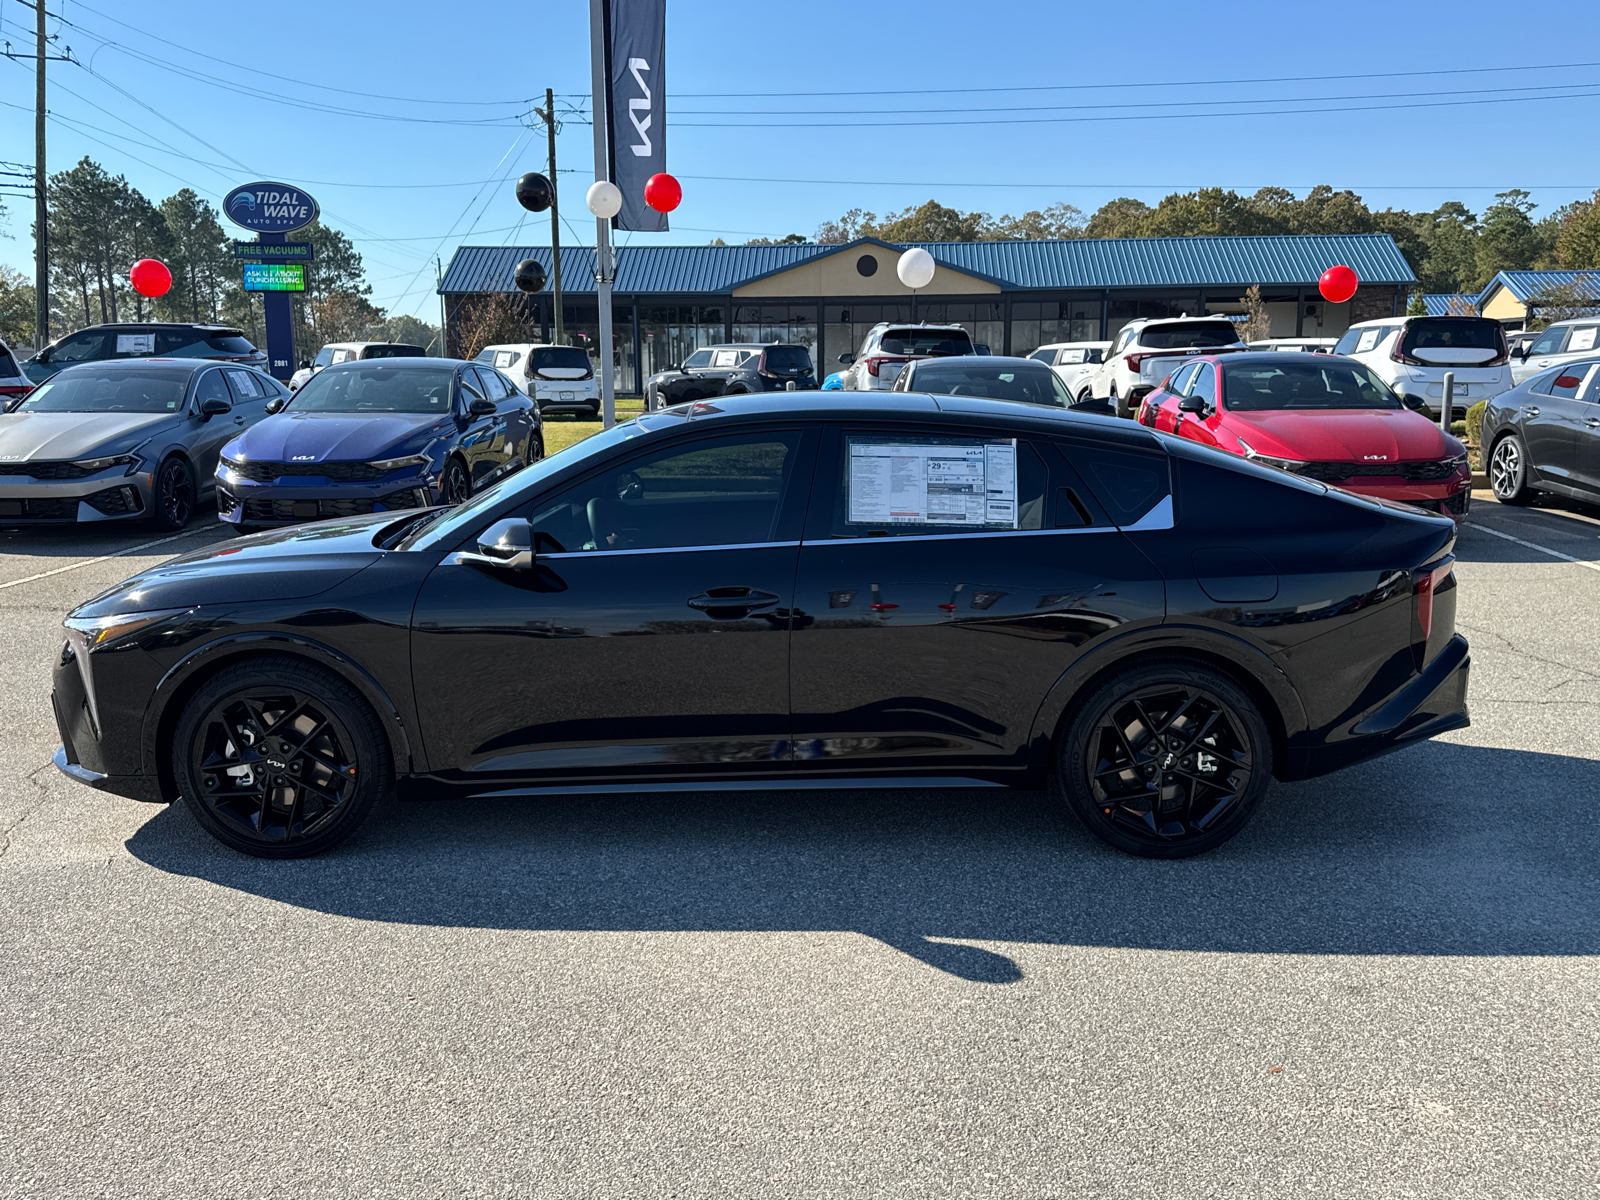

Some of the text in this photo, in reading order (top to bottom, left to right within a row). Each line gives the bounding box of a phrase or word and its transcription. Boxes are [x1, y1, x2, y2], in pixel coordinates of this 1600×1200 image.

[628, 57, 652, 157] KIA
[256, 191, 299, 205] TIDAL
[263, 205, 309, 219] WAVE
[237, 245, 308, 256] FREE VACUUMS
[931, 462, 942, 470] 29
